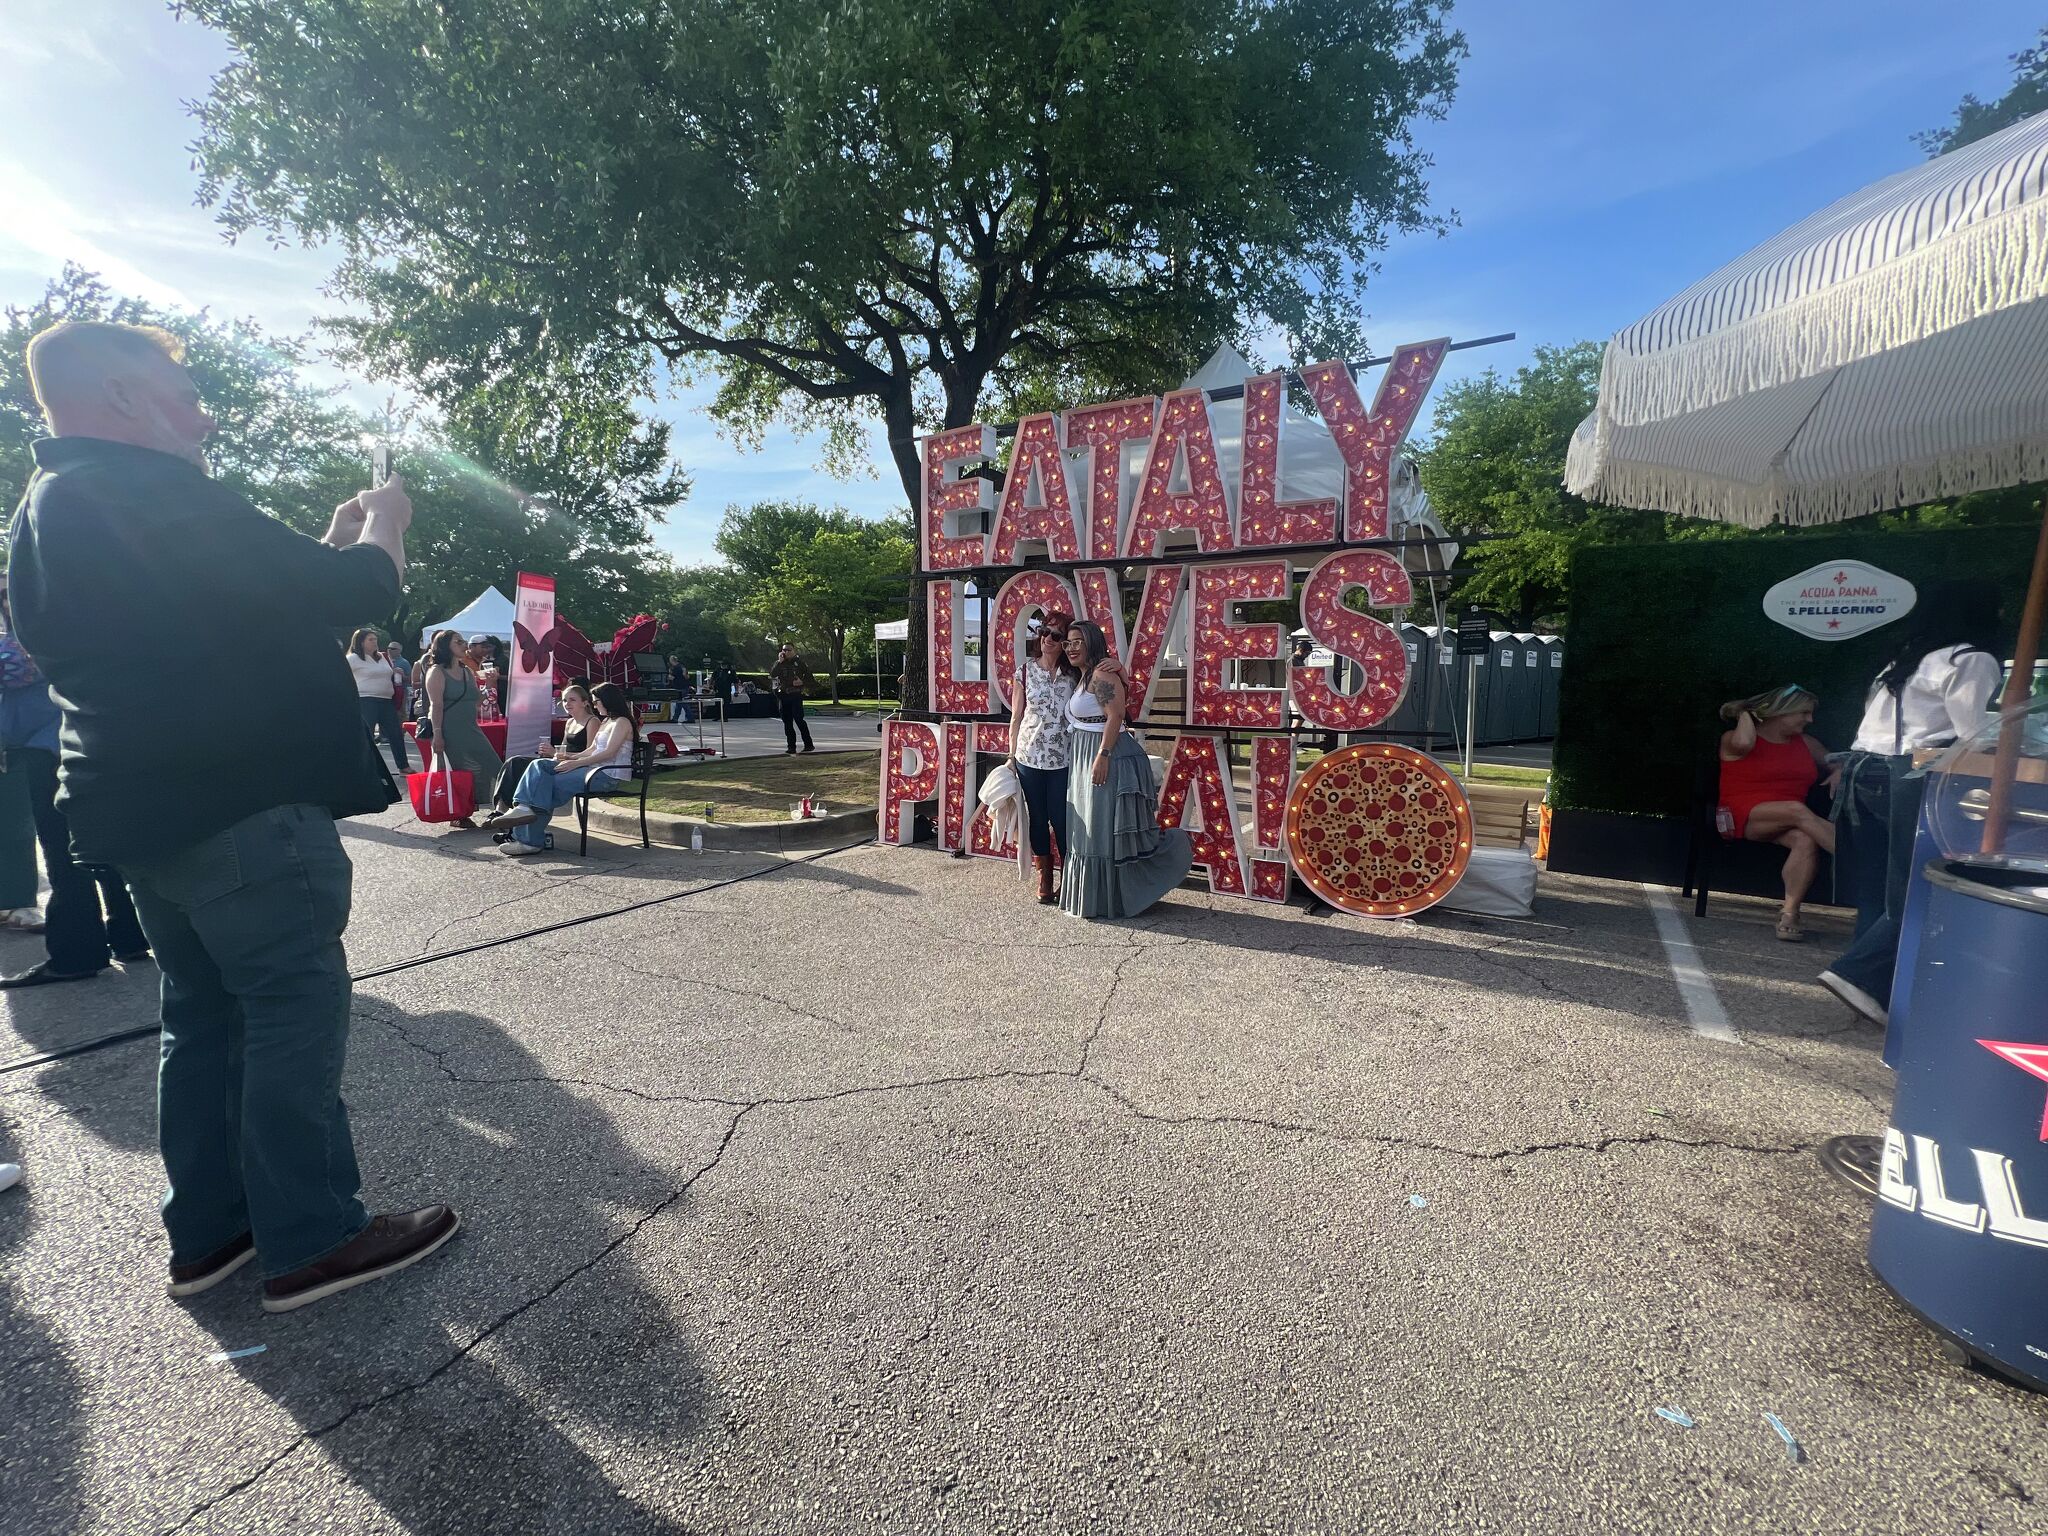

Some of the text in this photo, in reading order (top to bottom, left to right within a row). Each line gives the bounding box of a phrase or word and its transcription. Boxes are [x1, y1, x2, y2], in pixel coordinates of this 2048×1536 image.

[921, 338, 1451, 571] EATALY
[928, 548, 1413, 731] LOVES
[1788, 605, 1886, 615] S.PELLEGRINO
[1800, 586, 1878, 598] ACQUA PANNA
